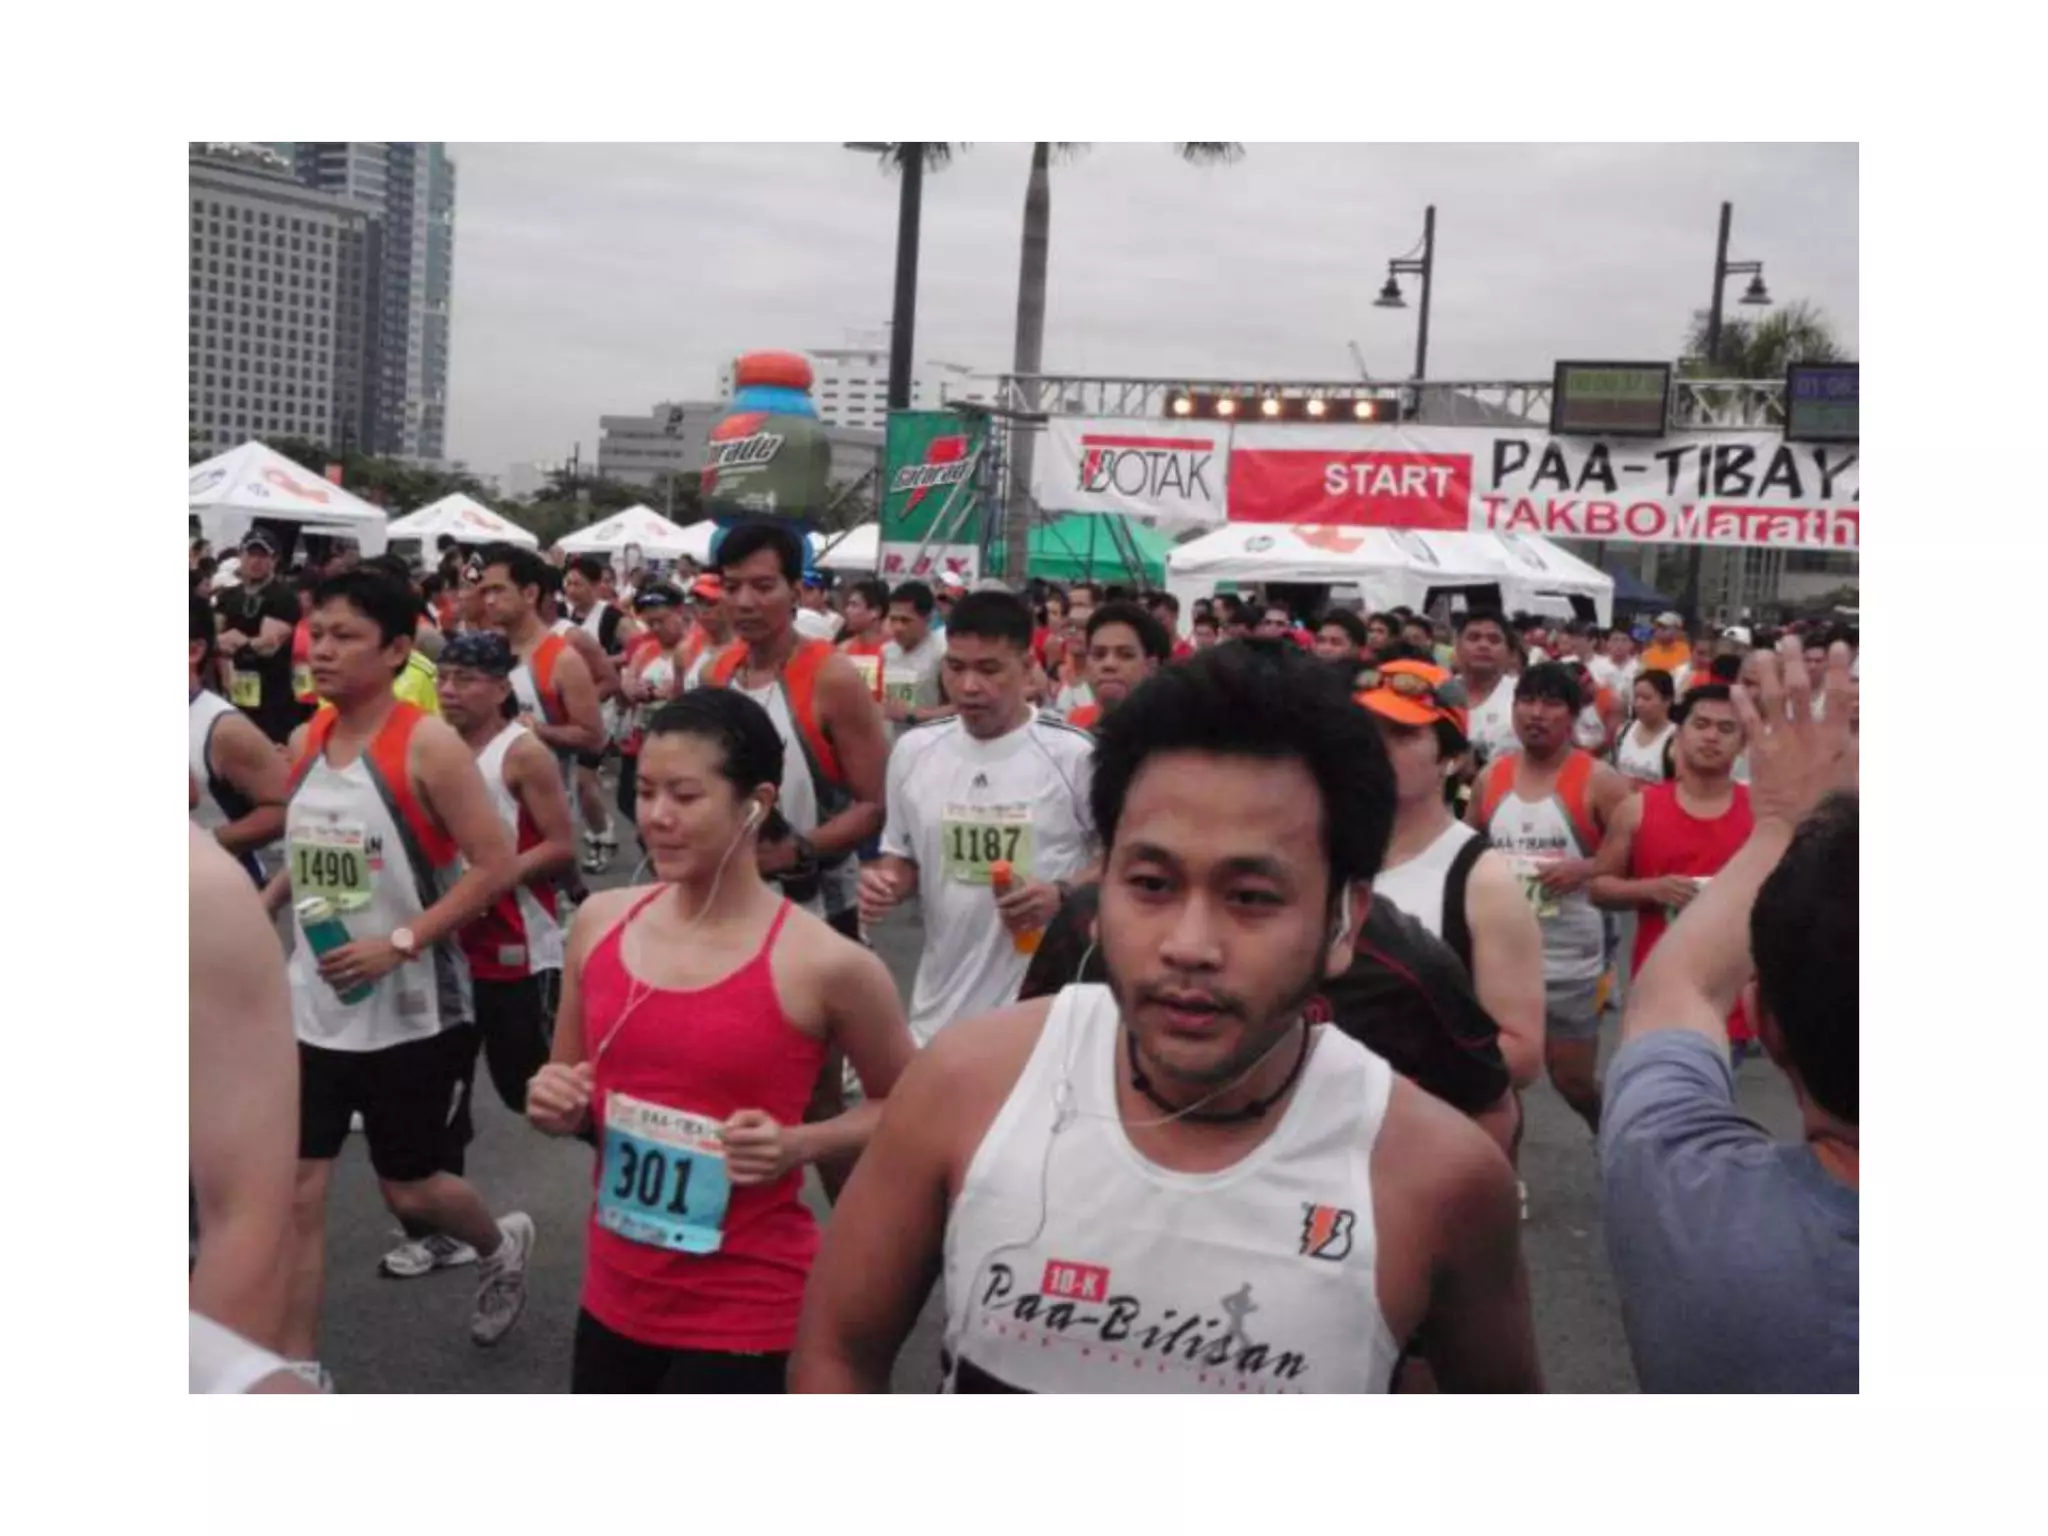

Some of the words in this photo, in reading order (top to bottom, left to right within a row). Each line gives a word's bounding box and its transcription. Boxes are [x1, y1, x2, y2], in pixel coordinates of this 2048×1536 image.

[1324, 463, 1454, 498] START
[1491, 438, 1859, 502] PAA-TIBAY
[1480, 494, 1667, 537] TAKBO
[953, 824, 1021, 863] 1187
[300, 848, 359, 889] 1490
[613, 1142, 693, 1215] 301
[1048, 1266, 1099, 1297] 10-K
[983, 1263, 1308, 1380] Paa-Bilisan
